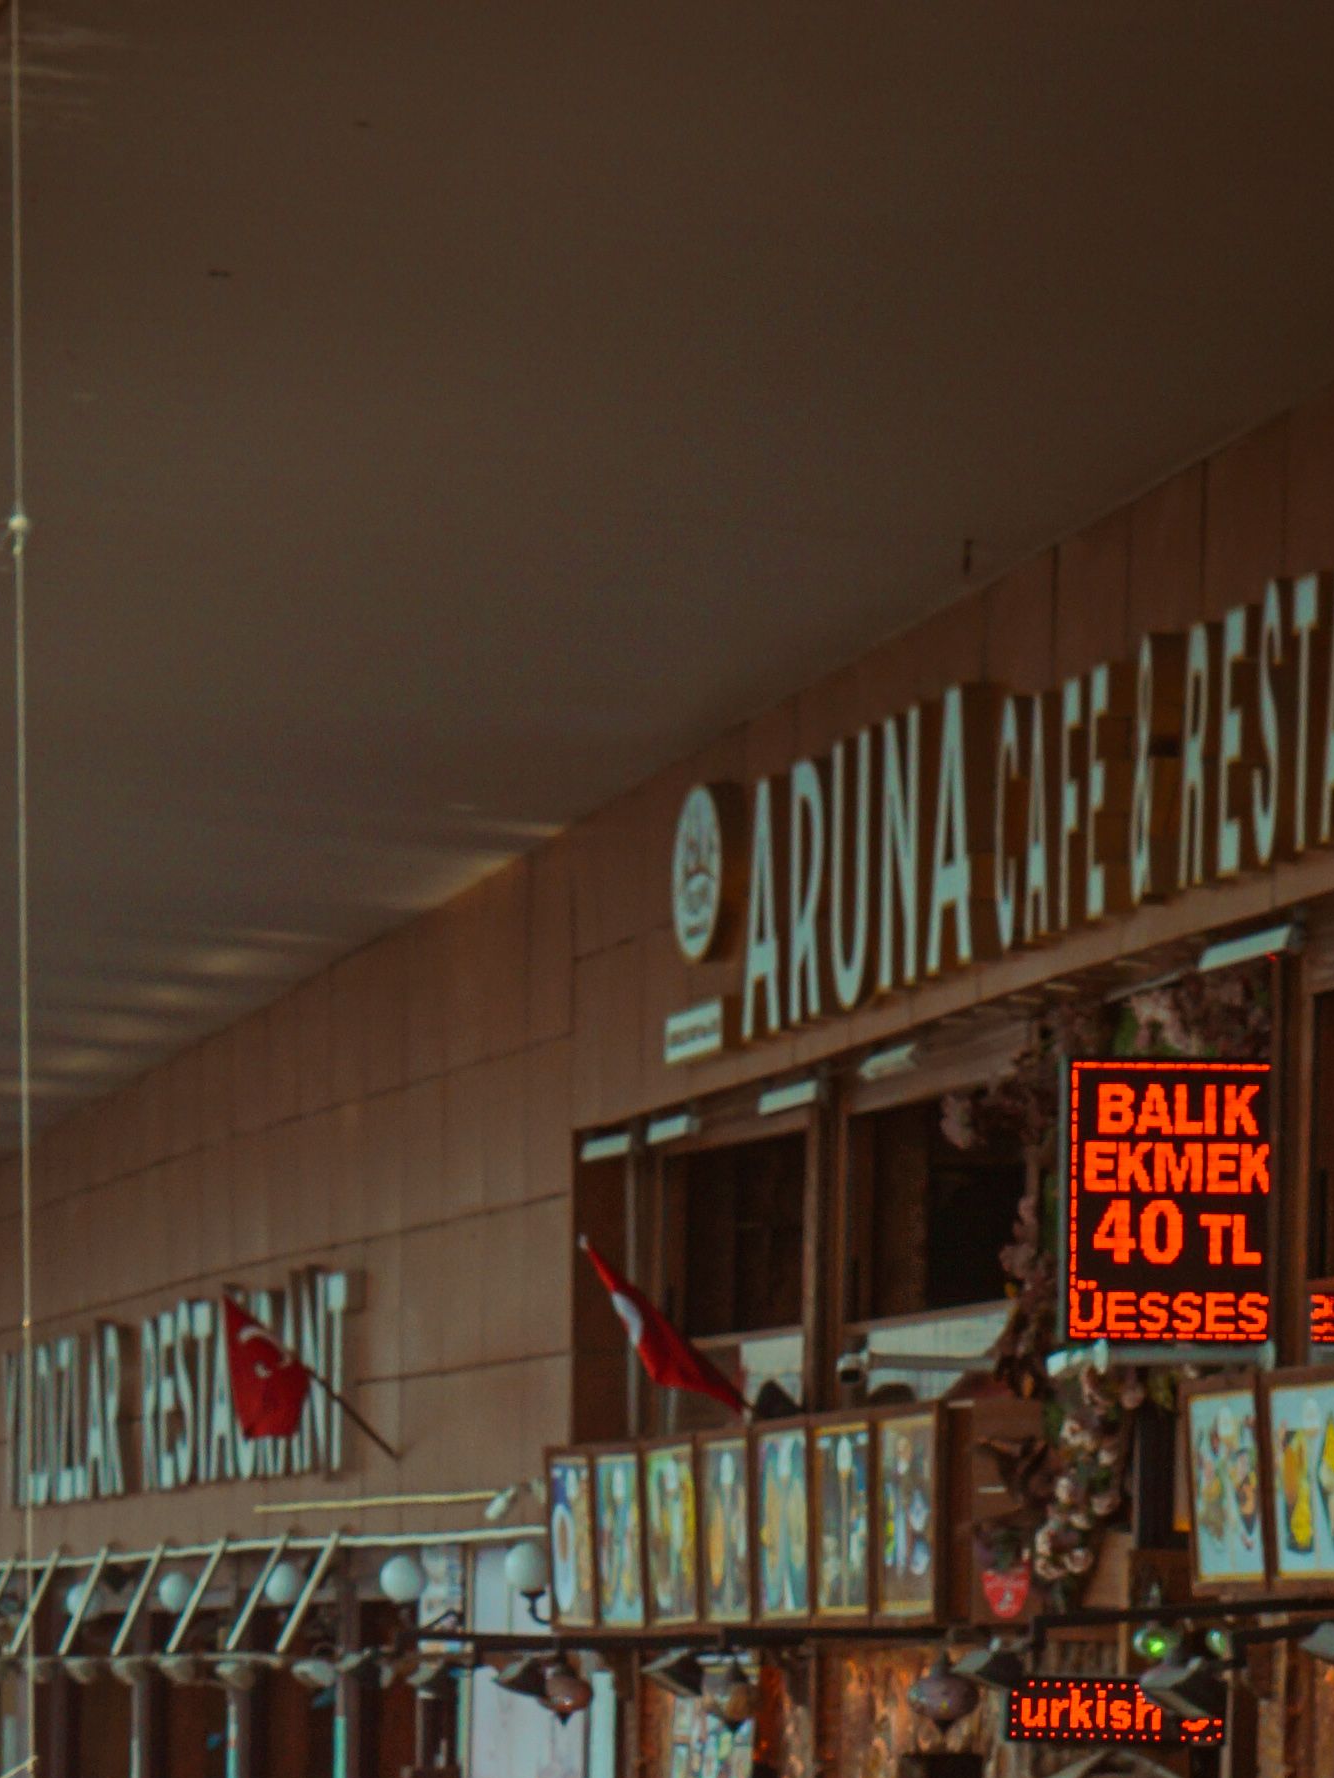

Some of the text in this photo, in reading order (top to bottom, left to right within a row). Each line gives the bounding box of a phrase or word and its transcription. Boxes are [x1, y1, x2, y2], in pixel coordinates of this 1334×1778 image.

[740, 684, 972, 1044] ARUNA
[993, 662, 1112, 952] CAFE
[1097, 1083, 1260, 1135] BALIK
[1083, 1141, 1270, 1193] EKMEK
[1093, 1199, 1263, 1265] 40 TL
